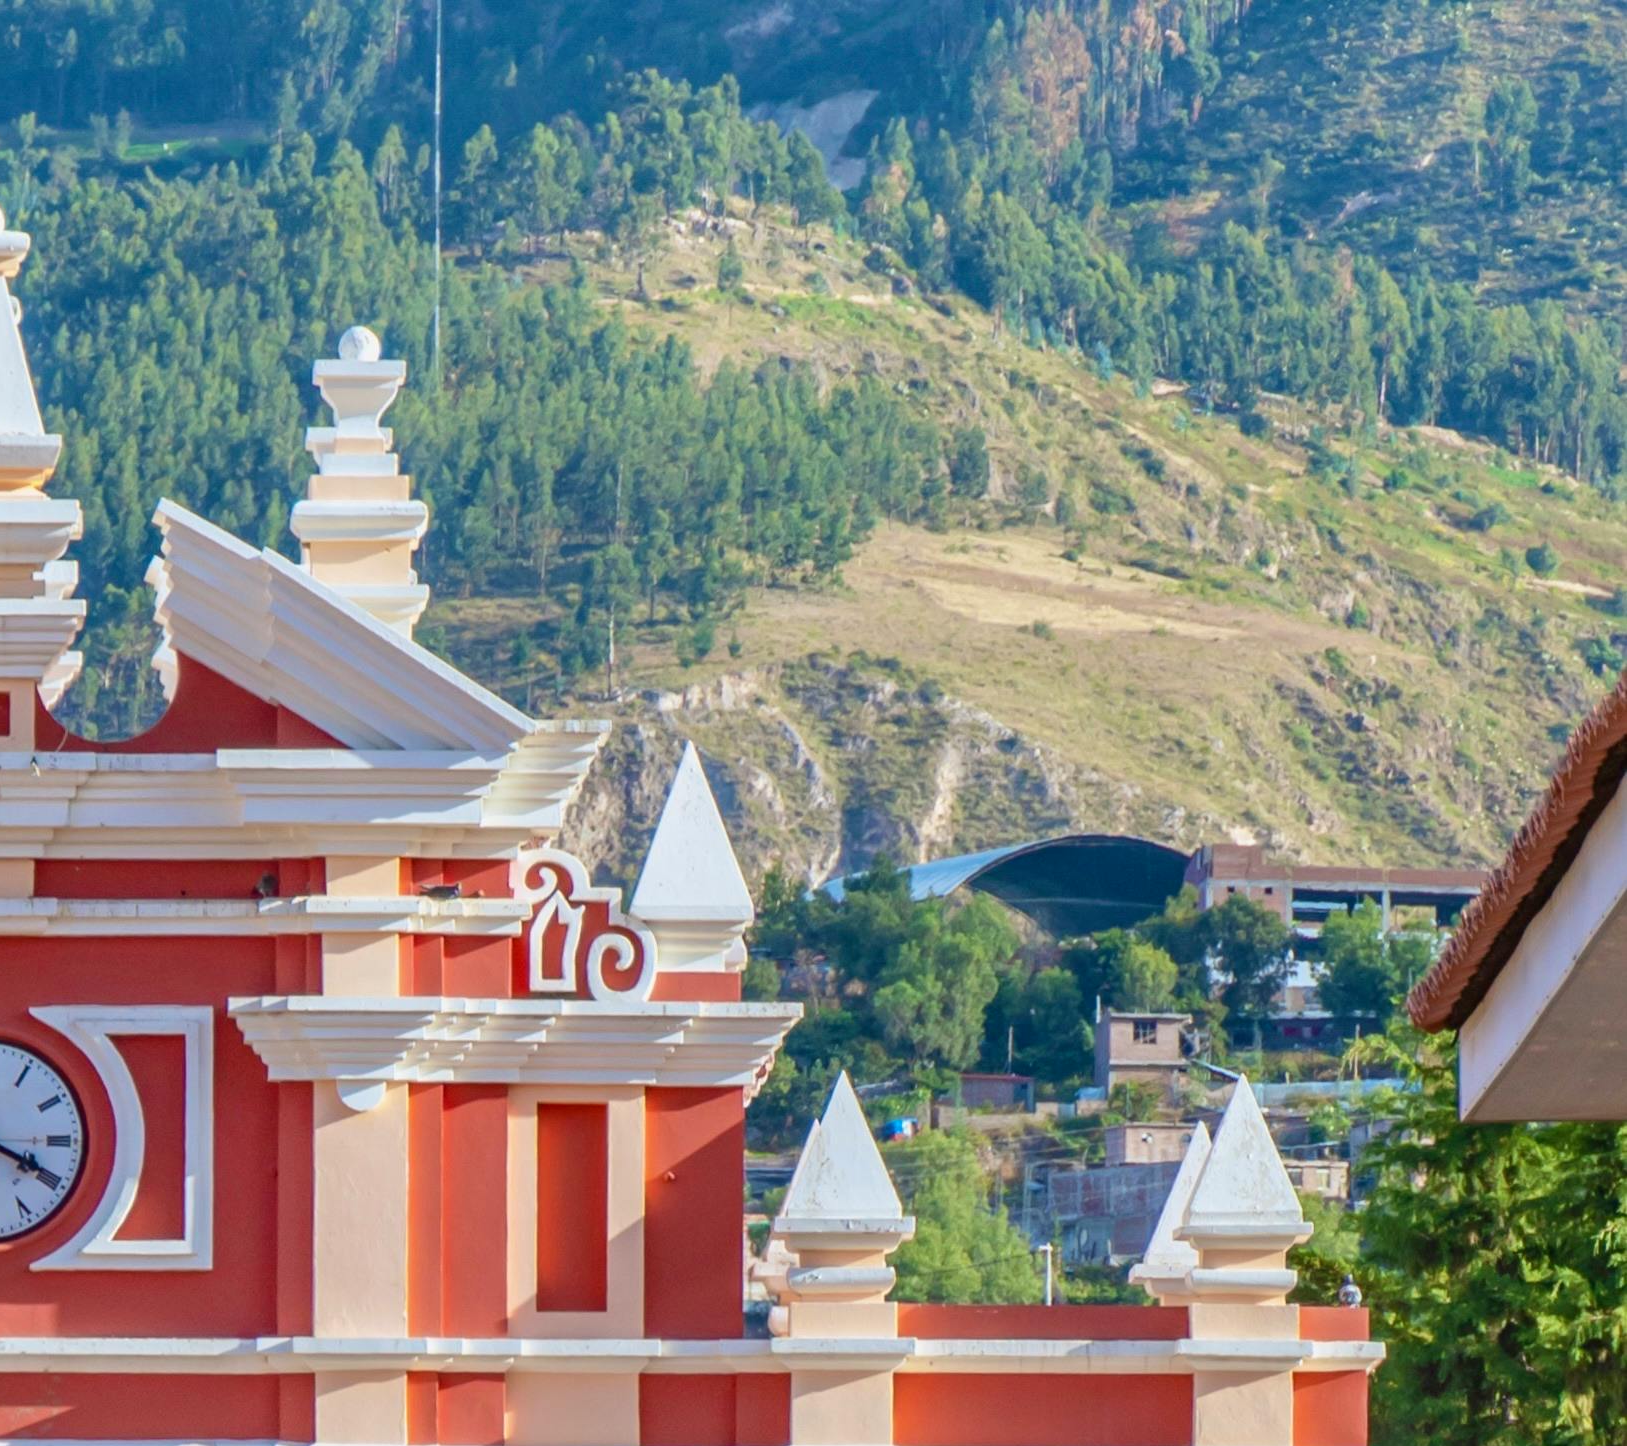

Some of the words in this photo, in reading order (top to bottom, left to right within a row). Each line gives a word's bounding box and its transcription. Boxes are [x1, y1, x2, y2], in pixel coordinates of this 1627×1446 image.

[14, 1064, 30, 1088] I
[37, 1094, 61, 1113] II
[46, 1134, 71, 1147] III
[15, 1195, 31, 1219] V
